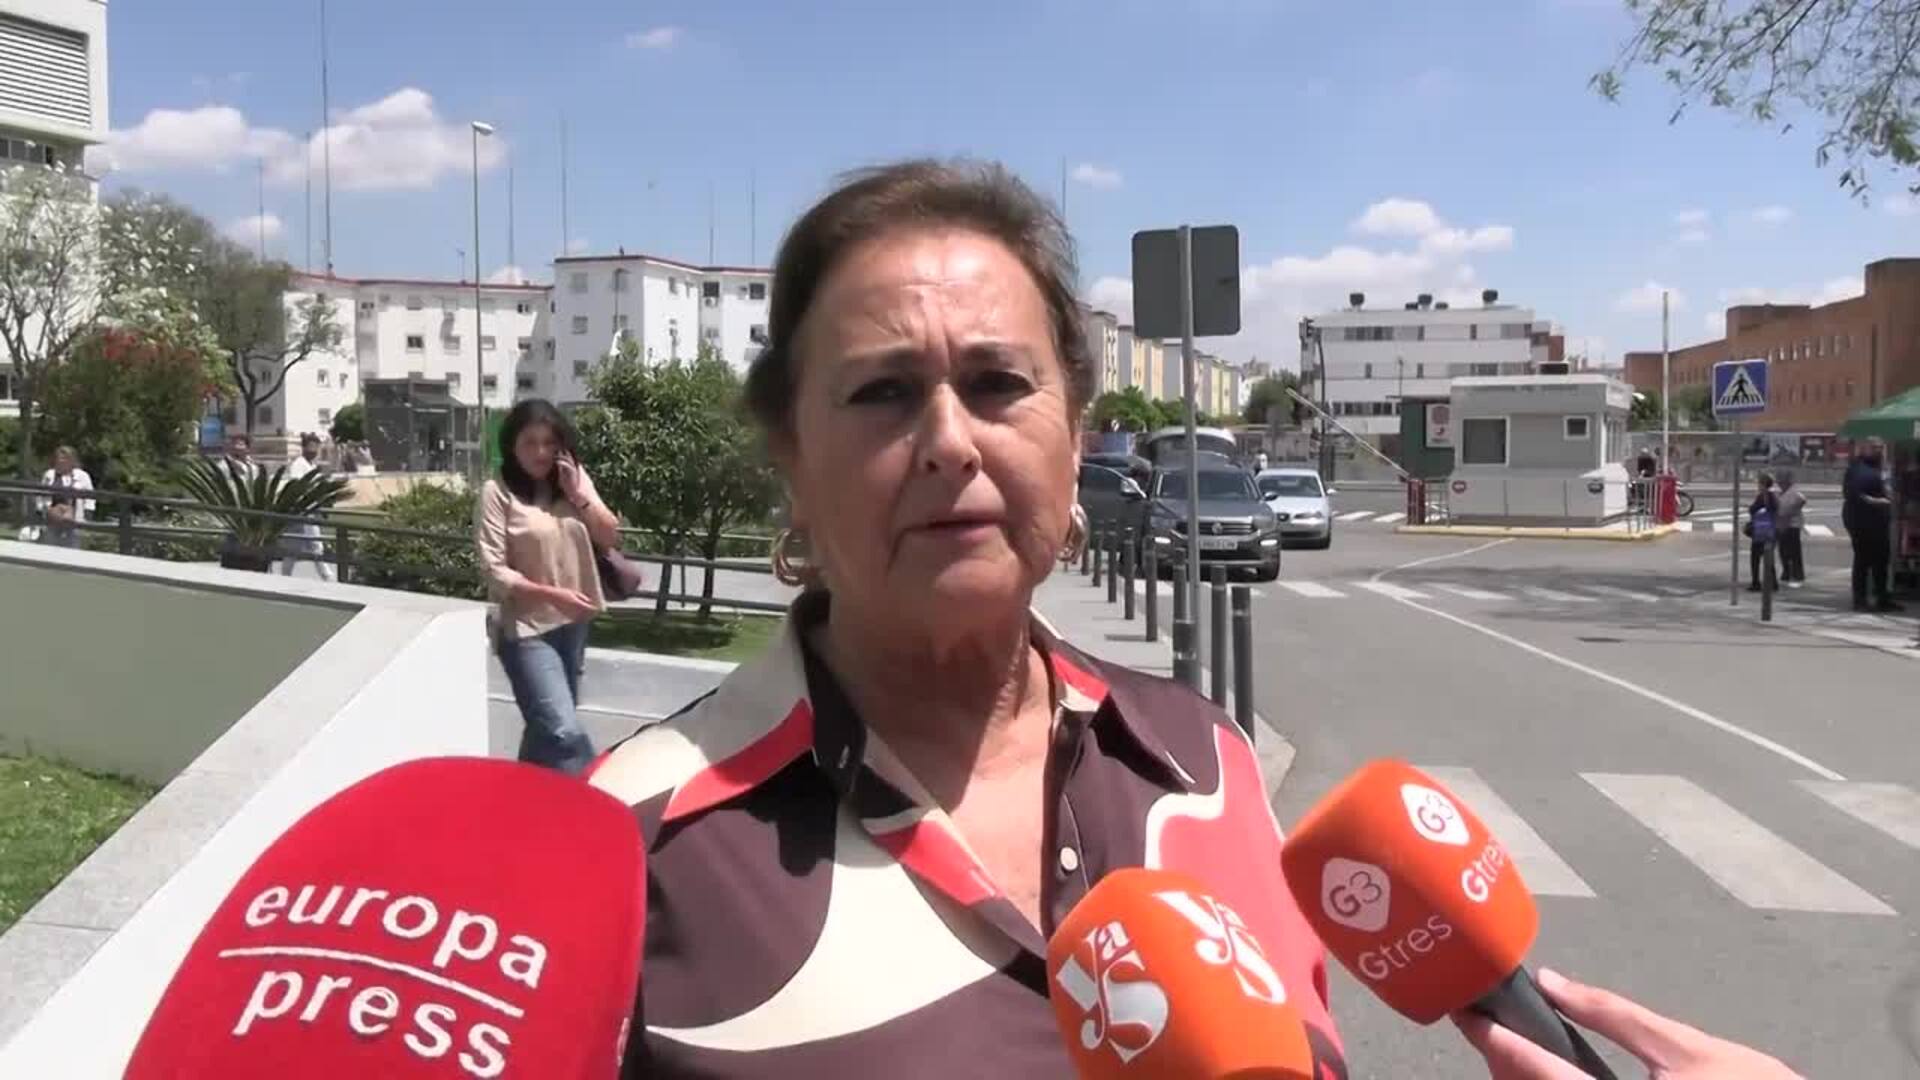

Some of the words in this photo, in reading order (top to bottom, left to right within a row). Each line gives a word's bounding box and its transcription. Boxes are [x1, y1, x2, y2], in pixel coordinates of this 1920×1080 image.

[1328, 870, 1383, 919] G3
[1461, 839, 1506, 903] Gtre
[245, 885, 549, 989] europa
[1356, 914, 1453, 980] Gtres
[232, 969, 512, 1079] press
